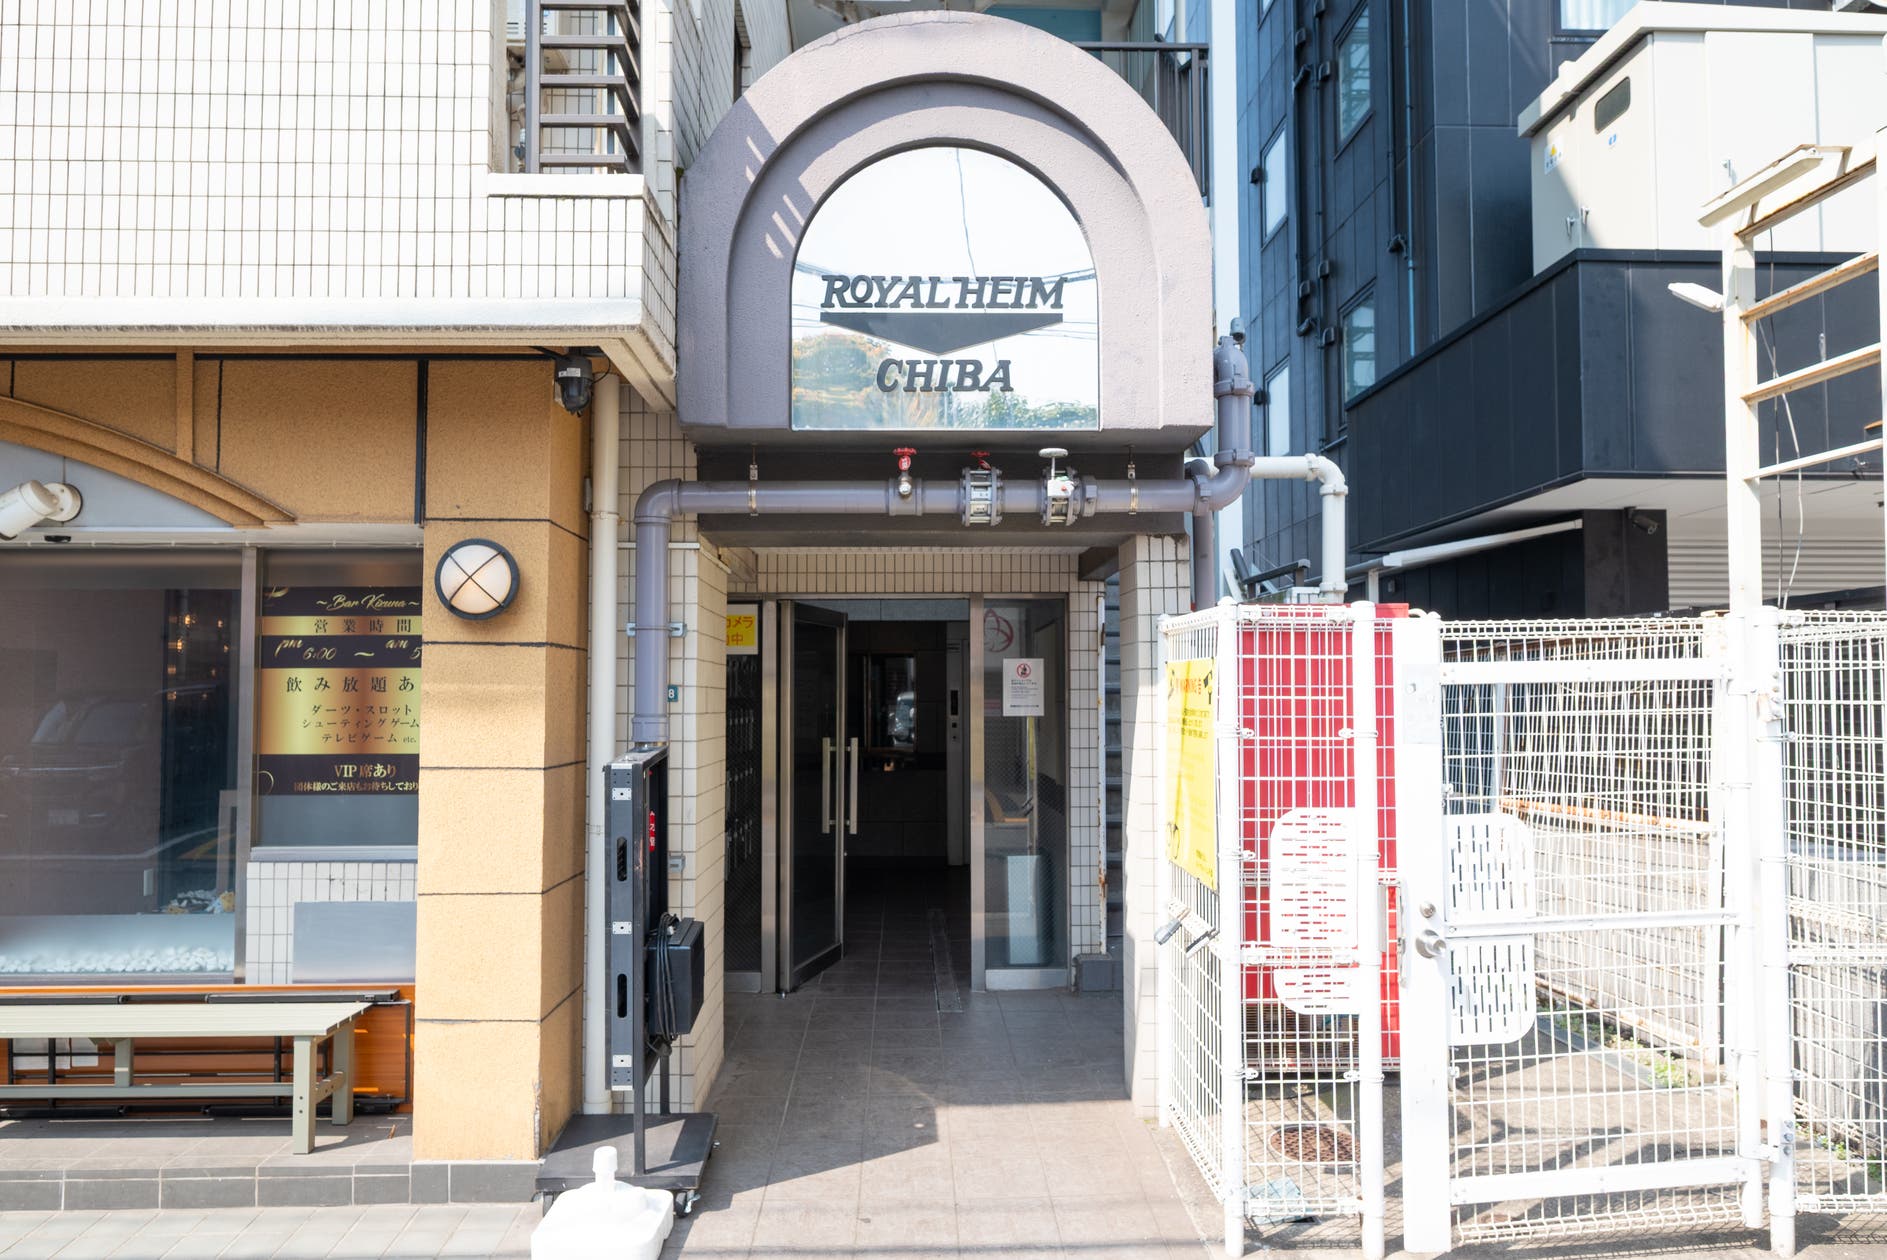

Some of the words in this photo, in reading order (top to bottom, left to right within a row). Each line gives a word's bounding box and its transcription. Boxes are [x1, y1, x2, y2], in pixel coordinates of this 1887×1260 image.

[876, 358, 1014, 393] CHIBA
[326, 593, 359, 612] Bar
[360, 593, 407, 611] Kizuna
[314, 618, 412, 633] 営業時間
[274, 639, 304, 657] pm
[303, 647, 337, 660] 6:00
[385, 639, 409, 649] am
[286, 676, 415, 693] 飲み放題あ
[312, 704, 412, 715] ダーツ・スロット
[322, 733, 398, 743] テレビゲーム
